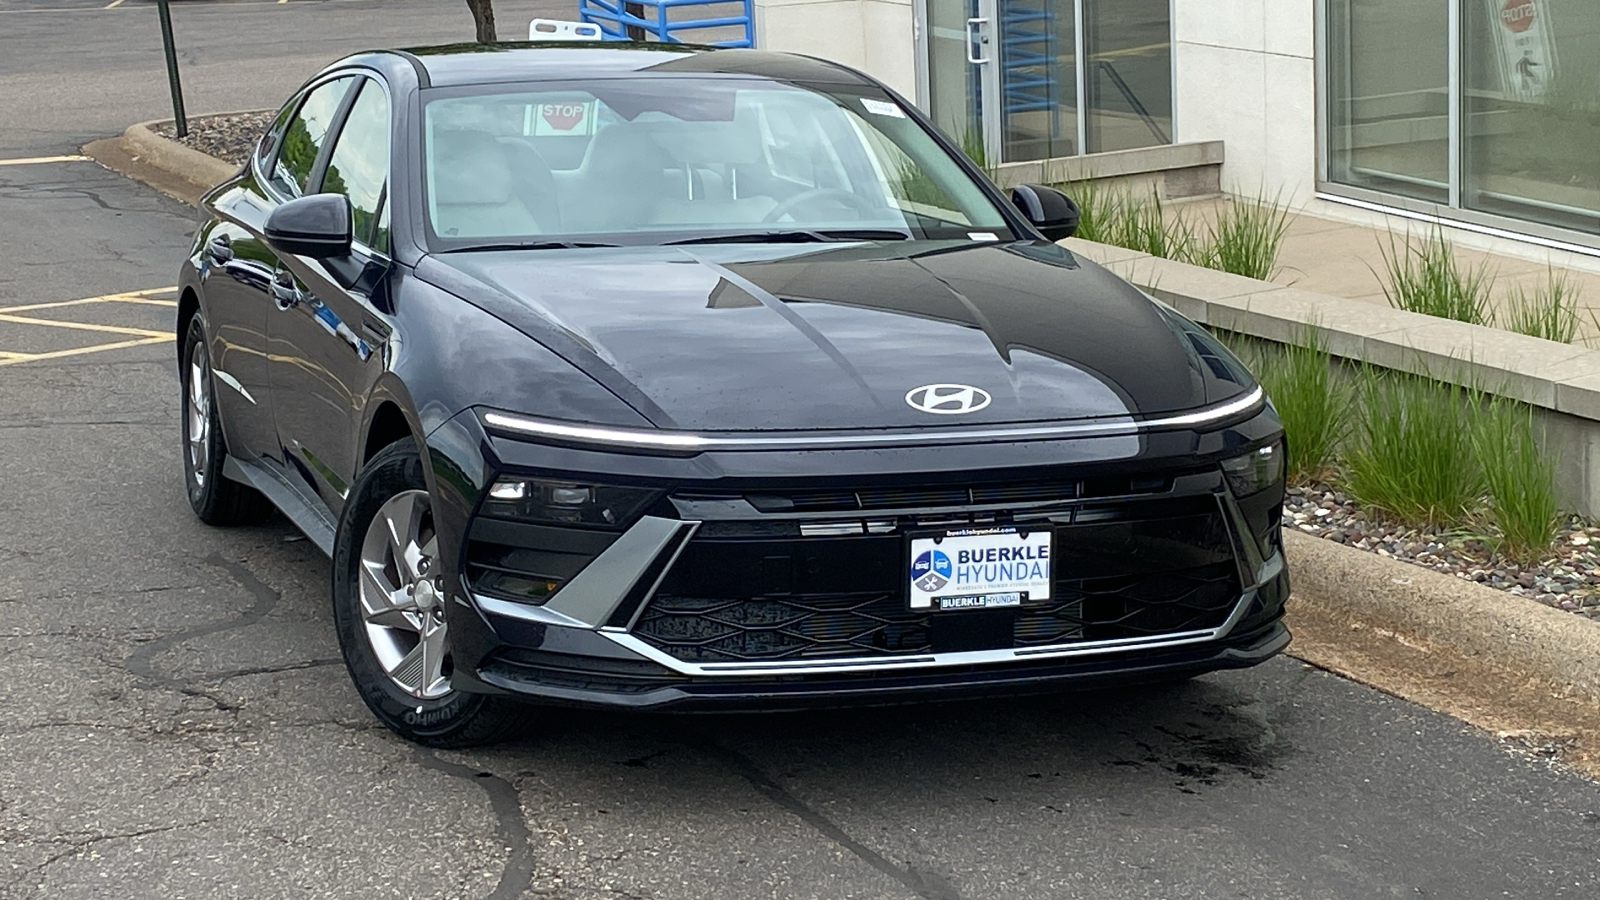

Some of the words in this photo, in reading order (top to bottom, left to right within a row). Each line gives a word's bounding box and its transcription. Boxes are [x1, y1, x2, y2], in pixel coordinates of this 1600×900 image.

[543, 104, 583, 117] STOP
[958, 545, 1049, 564] BUERKLE
[957, 561, 1049, 584] HYUNDAI
[942, 596, 985, 608] BUERKLE
[986, 594, 1019, 605] HYUNDAI
